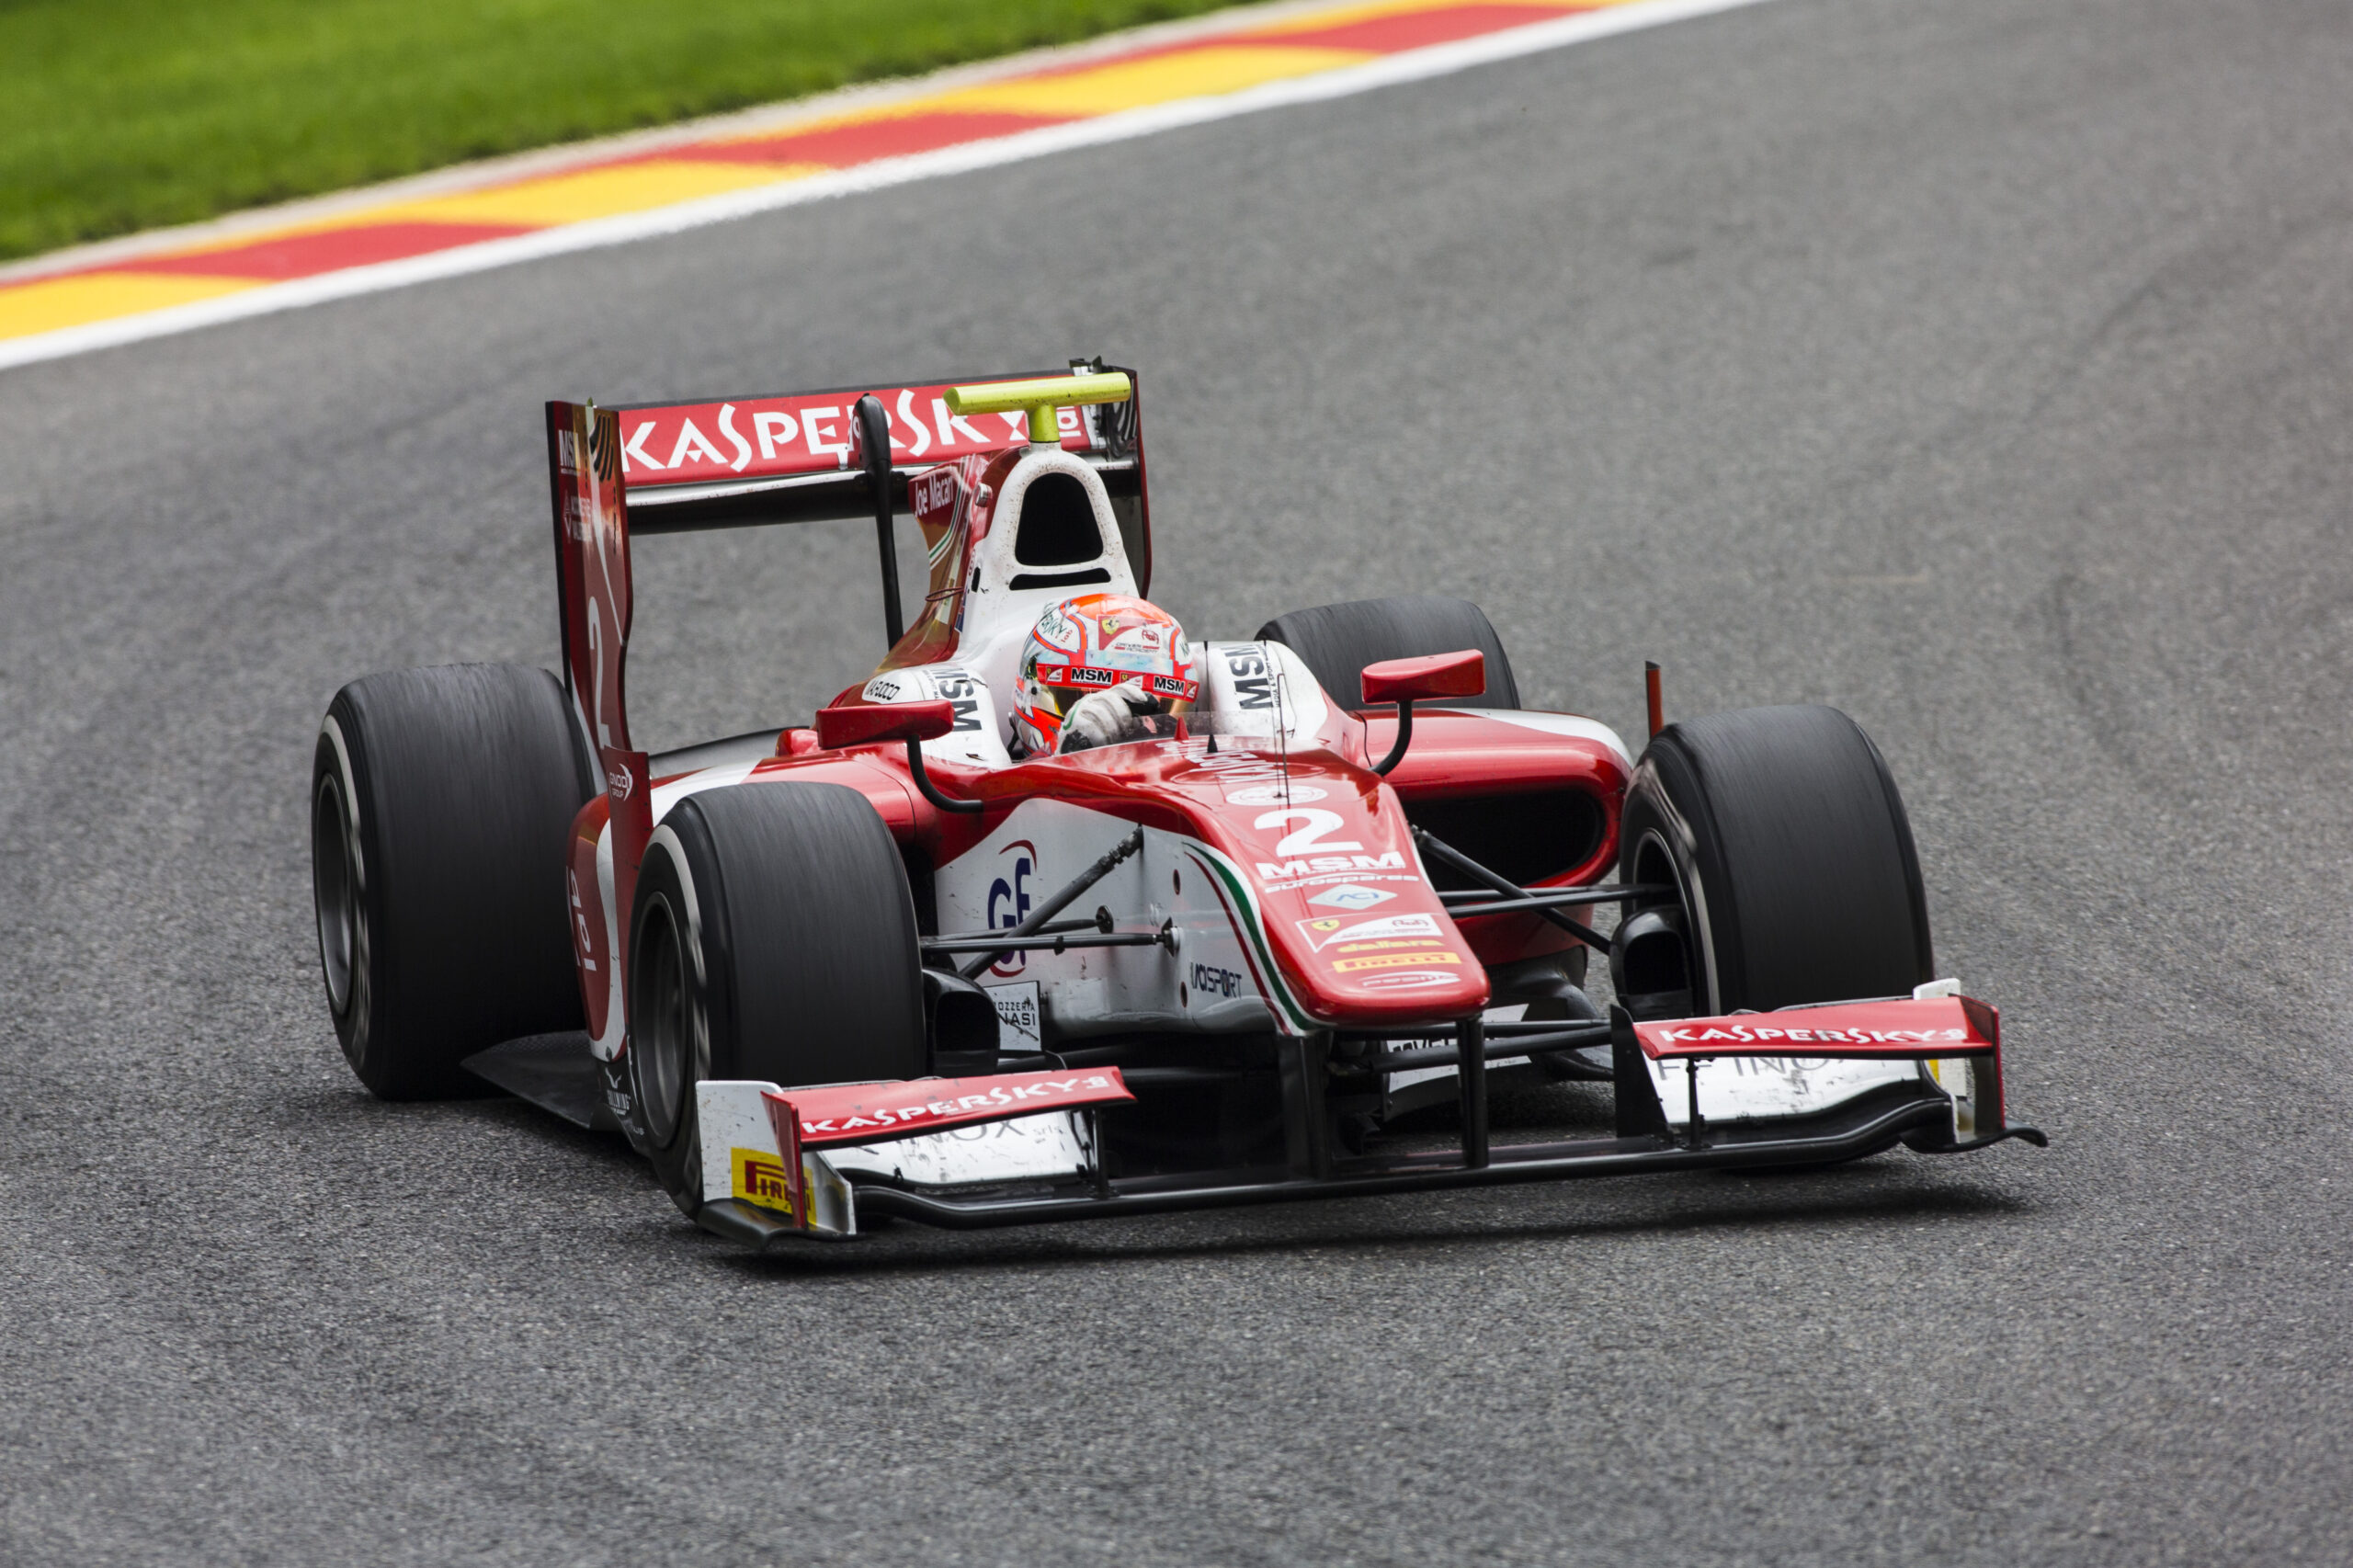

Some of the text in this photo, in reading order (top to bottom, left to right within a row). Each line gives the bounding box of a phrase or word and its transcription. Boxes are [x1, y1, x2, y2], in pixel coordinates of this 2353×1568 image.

[1071, 668, 1112, 683] MSM
[1154, 676, 1185, 693] MSM
[1220, 644, 1274, 710] MSM
[1254, 808, 1364, 858] 2
[1256, 851, 1406, 880] MSM
[1658, 1025, 1937, 1044] KASPERSKY
[801, 1078, 1078, 1134] KASPERSKY
